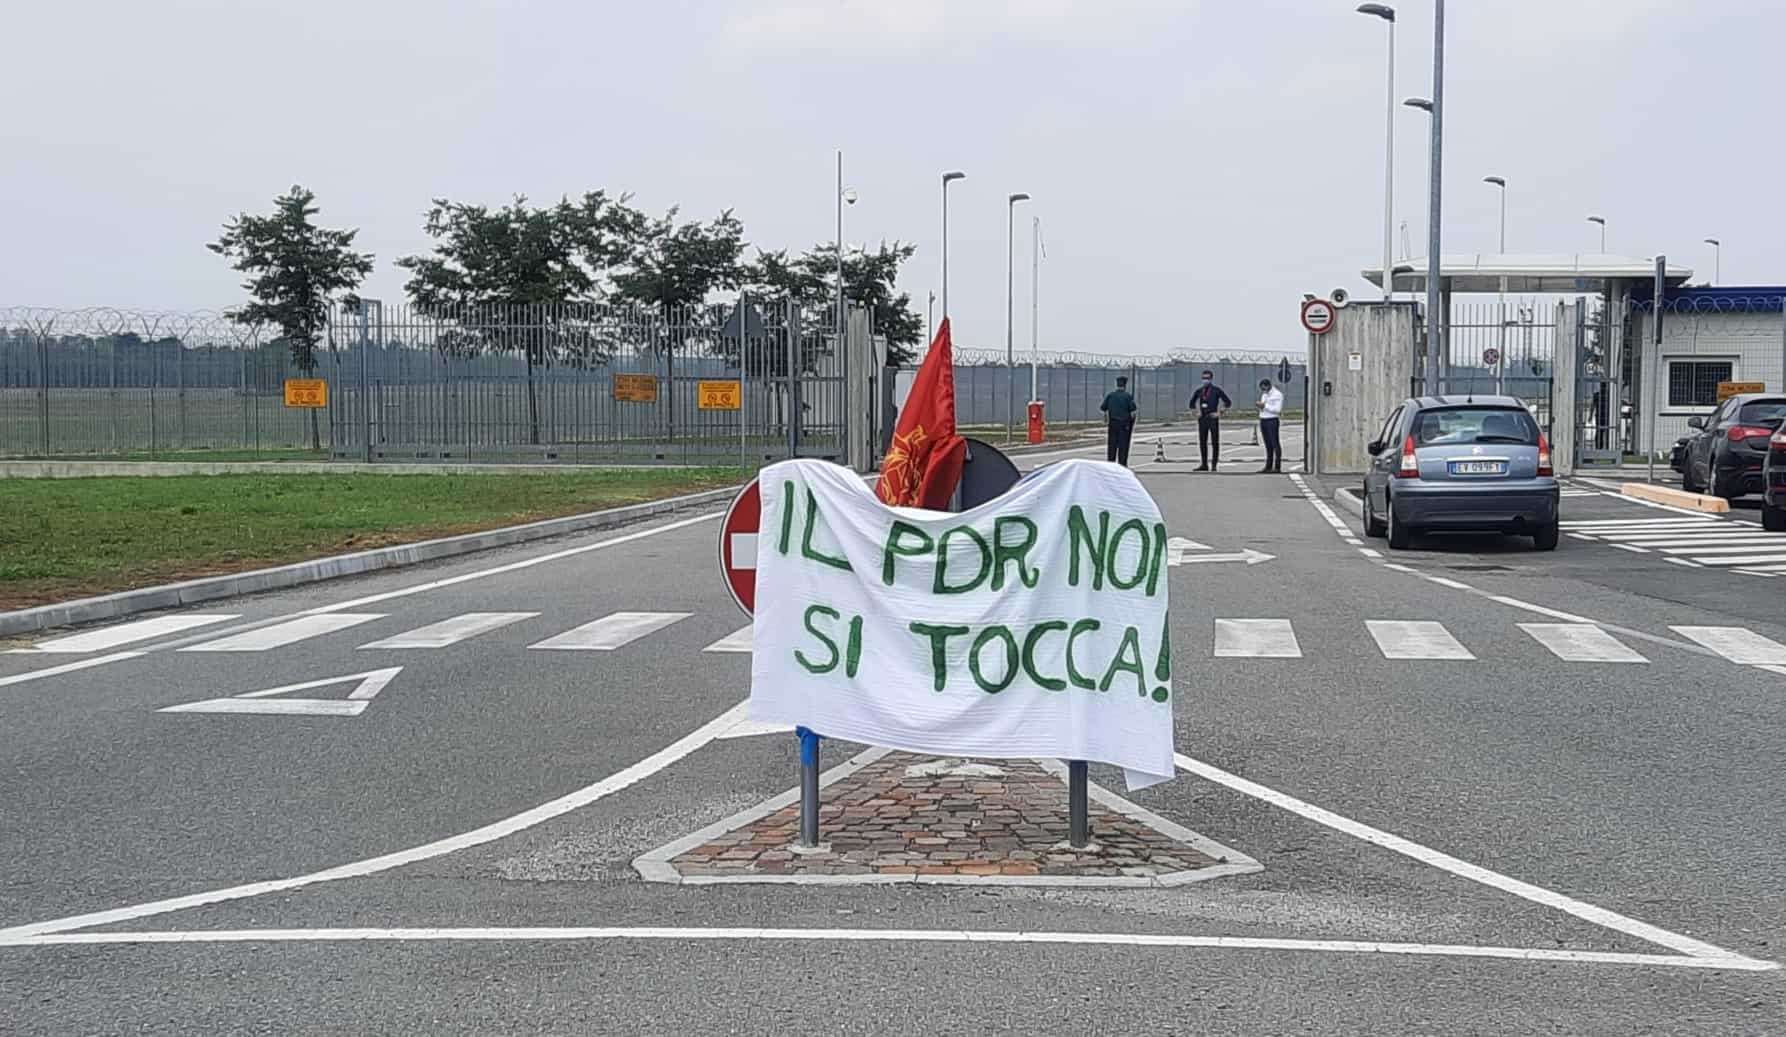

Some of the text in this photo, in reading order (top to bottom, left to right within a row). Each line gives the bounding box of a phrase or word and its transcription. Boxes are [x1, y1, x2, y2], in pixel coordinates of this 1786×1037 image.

[779, 480, 854, 573] IL
[882, 516, 1040, 594] PDR
[795, 604, 1171, 703] SI TOCCA!
